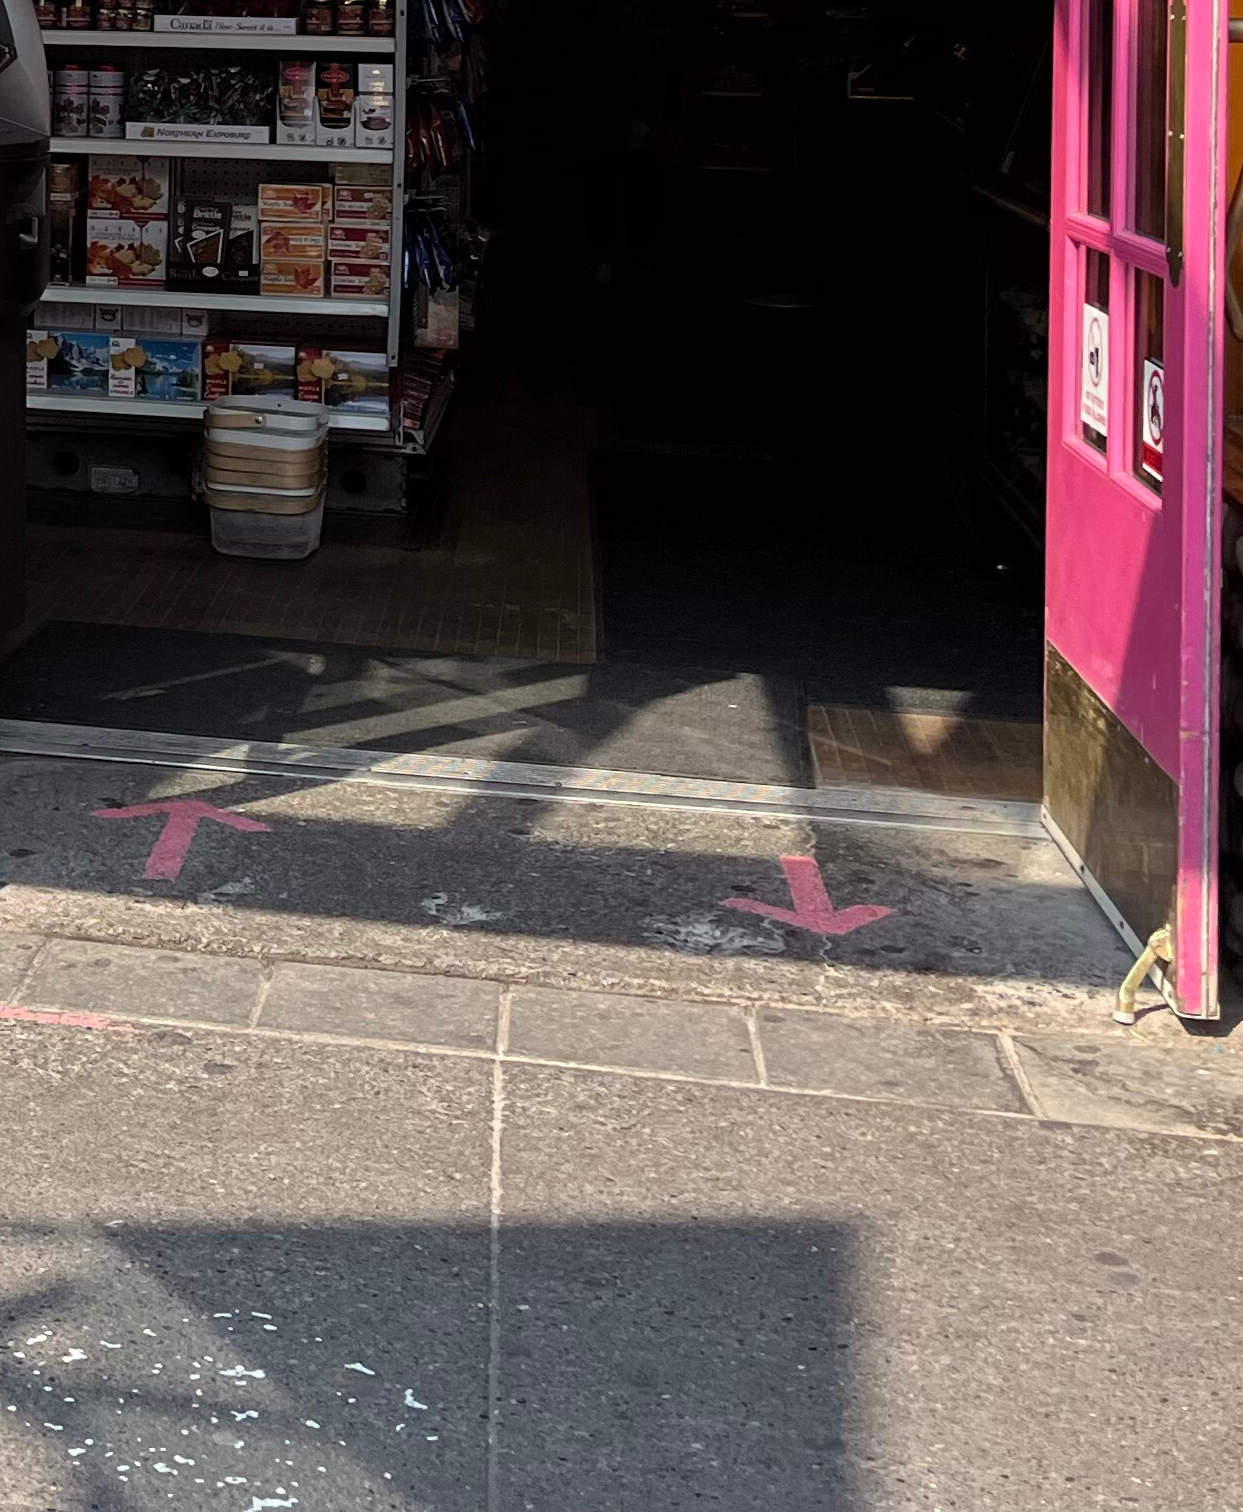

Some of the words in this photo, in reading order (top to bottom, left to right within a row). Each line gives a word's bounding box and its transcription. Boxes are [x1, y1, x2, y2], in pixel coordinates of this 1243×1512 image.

[170, 18, 213, 31] Canada
[206, 129, 252, 140] EXPOSURE
[193, 206, 223, 220] Brittle
